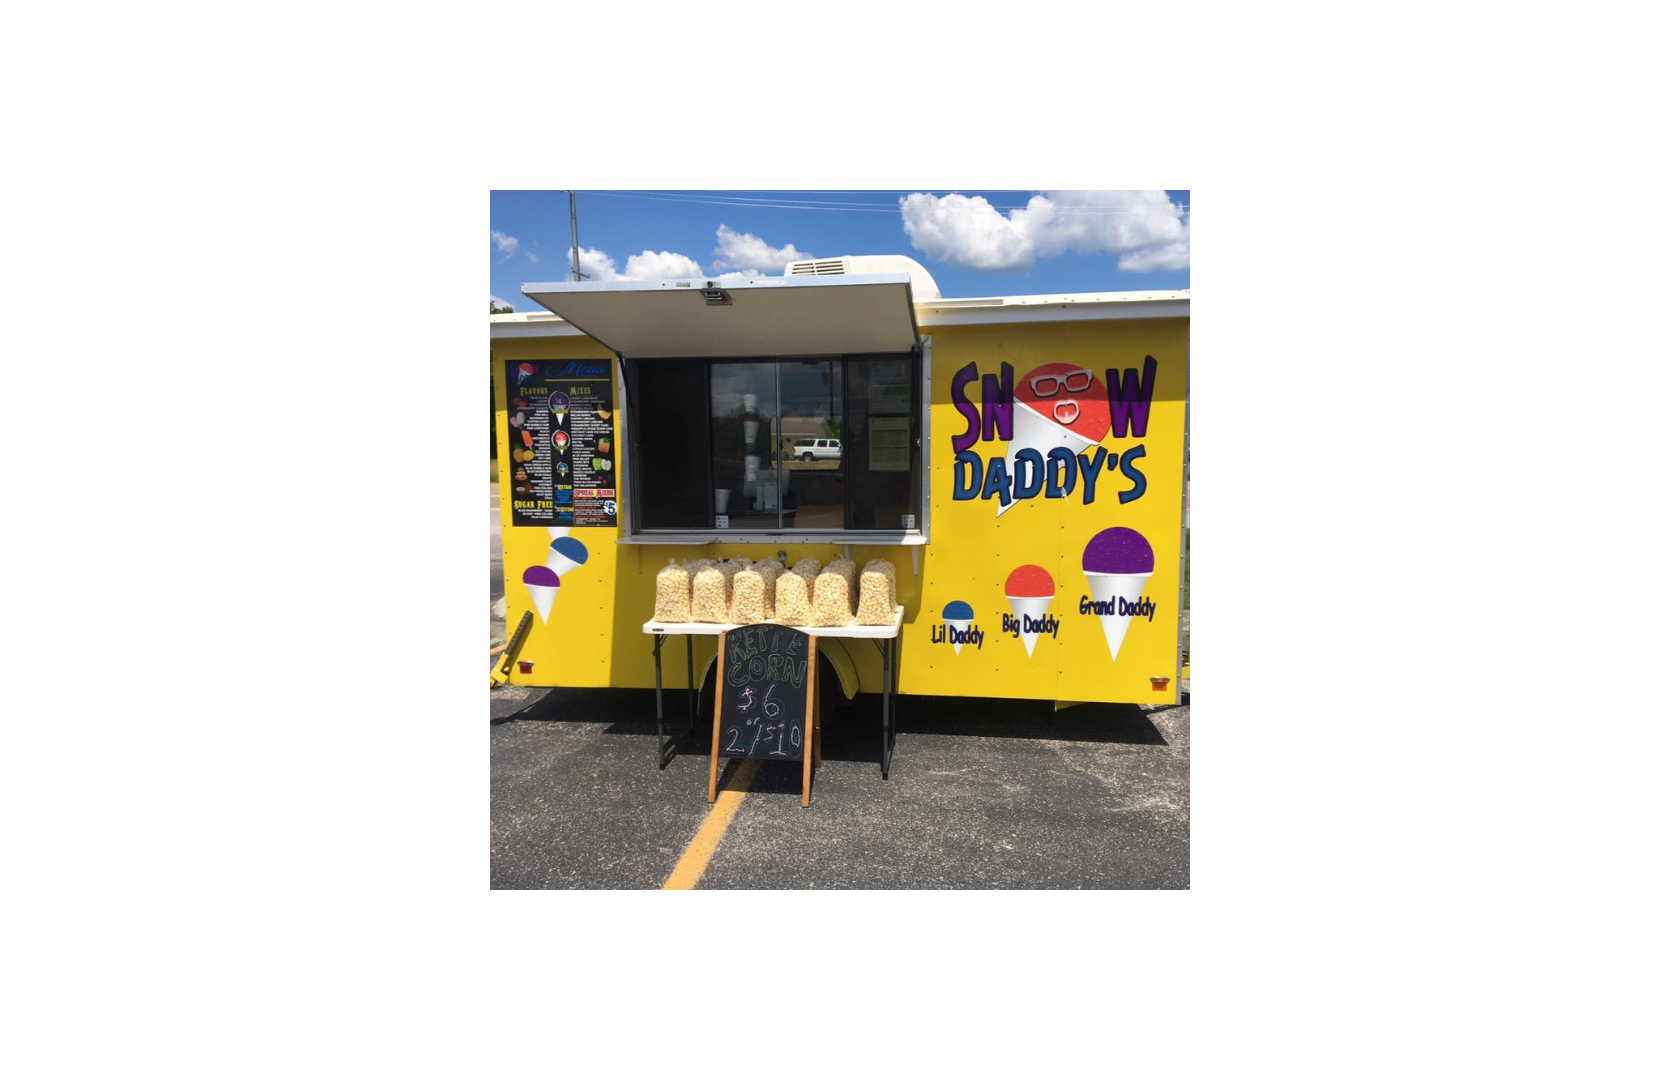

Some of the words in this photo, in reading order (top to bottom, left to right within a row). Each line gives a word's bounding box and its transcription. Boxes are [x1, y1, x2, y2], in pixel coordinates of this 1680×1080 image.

[545, 361, 606, 378] Menu
[520, 387, 549, 396] FLAVORS
[570, 387, 591, 396] MIXES
[952, 444, 1148, 507] DADDY'S
[514, 500, 535, 509] SUGAR
[537, 500, 554, 509] FREE
[1079, 595, 1116, 616] Grand
[1118, 596, 1157, 623] Daddy
[932, 624, 946, 644] Lil
[949, 625, 985, 650] Daddy
[1002, 613, 1020, 638] Big
[1023, 614, 1060, 639] Daddy
[728, 654, 807, 689] CORN
